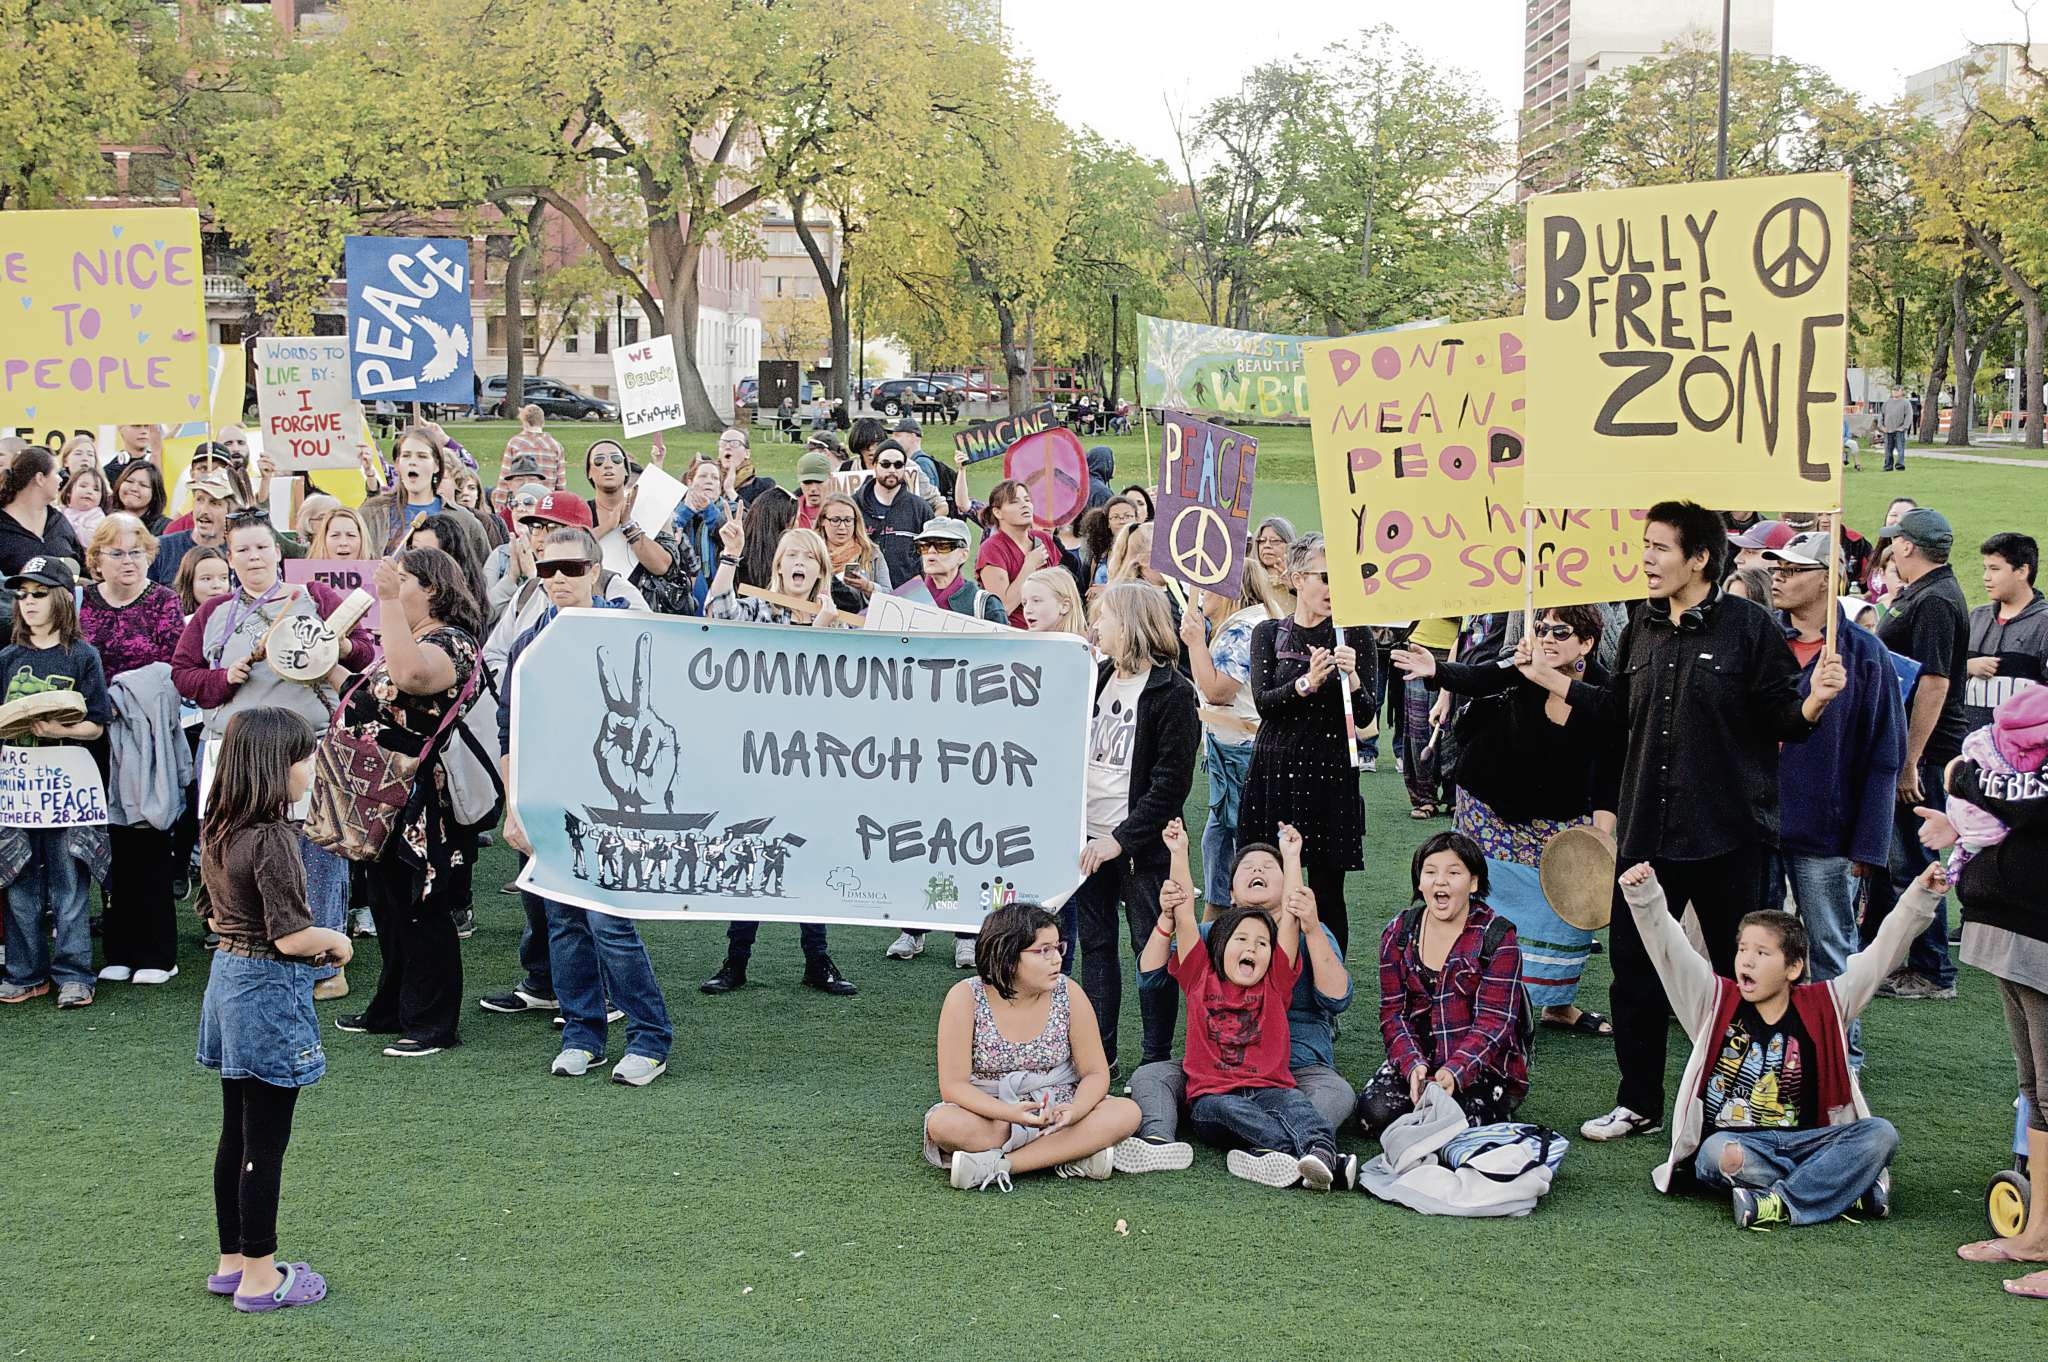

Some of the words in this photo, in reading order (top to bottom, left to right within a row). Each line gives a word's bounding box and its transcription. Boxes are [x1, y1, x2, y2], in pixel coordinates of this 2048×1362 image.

[0, 253, 28, 283] E
[72, 243, 193, 292] NICE
[1544, 209, 1718, 321] BULLY
[51, 303, 101, 346] TO
[355, 243, 464, 396] PEACE
[1588, 273, 1732, 352] FREE
[266, 343, 319, 361] WORDS
[323, 346, 345, 361] TO
[628, 347, 653, 362] WE
[5, 356, 172, 393] PEOPLE
[265, 366, 301, 386] LIVE
[1331, 392, 1496, 434] MEAN
[1593, 313, 1845, 482] ZONE
[271, 412, 342, 434] FORGIVE
[956, 408, 1051, 460] IMAGINE
[1166, 422, 1256, 518] PEACE
[314, 571, 363, 590] END
[34, 764, 63, 777] the
[742, 730, 923, 784] MARCH
[937, 738, 1038, 788] FOR
[41, 787, 100, 811] PEACE
[857, 815, 1034, 868] PEACE
